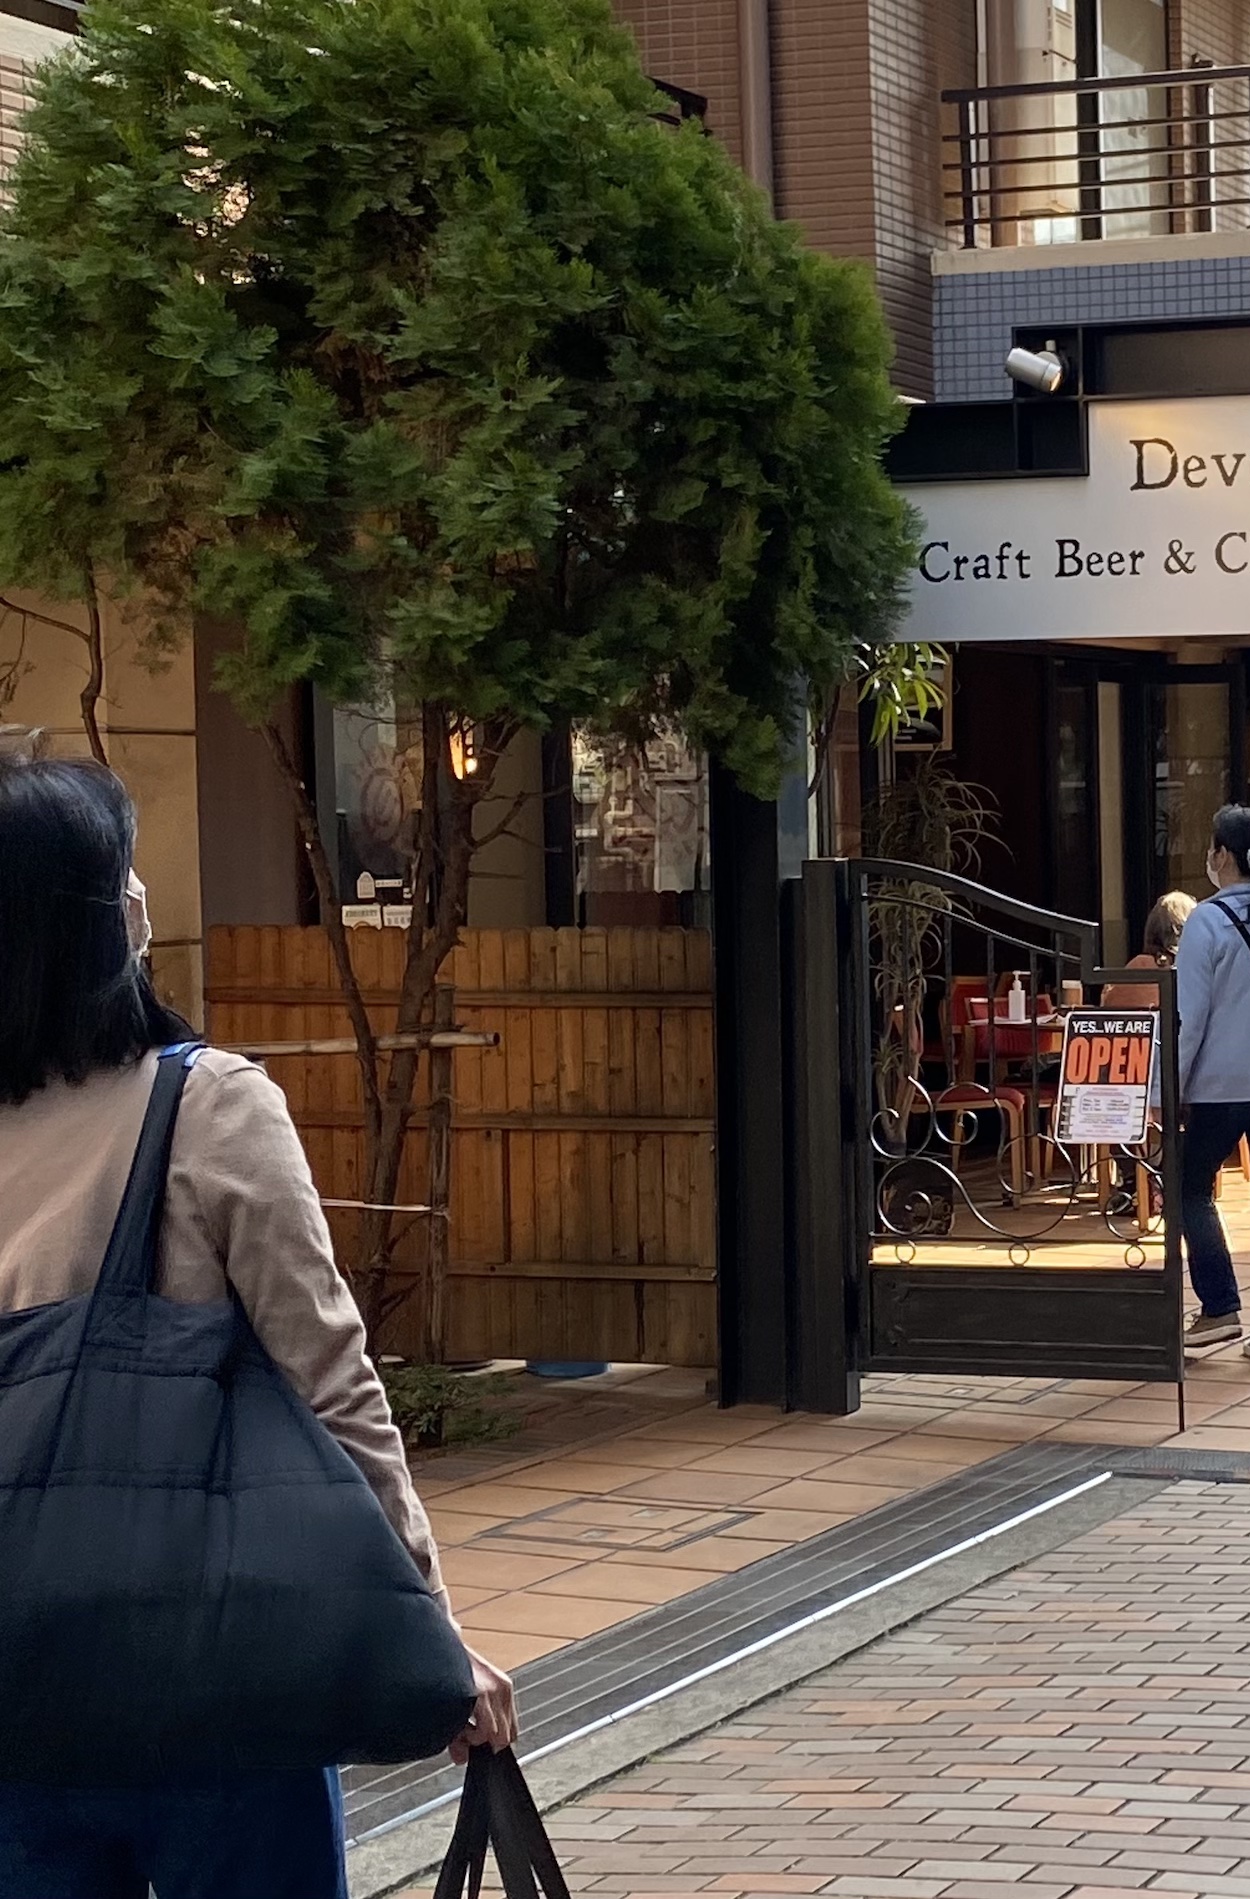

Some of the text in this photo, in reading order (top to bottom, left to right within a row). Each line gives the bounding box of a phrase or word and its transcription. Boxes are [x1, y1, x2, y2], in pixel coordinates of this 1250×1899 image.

[920, 538, 1032, 584] Craft
[1055, 537, 1145, 578] Beer
[1164, 540, 1196, 575] &
[1104, 1021, 1125, 1034] WE
[1125, 1021, 1151, 1034] ARE
[1066, 1036, 1150, 1083] OPEN
